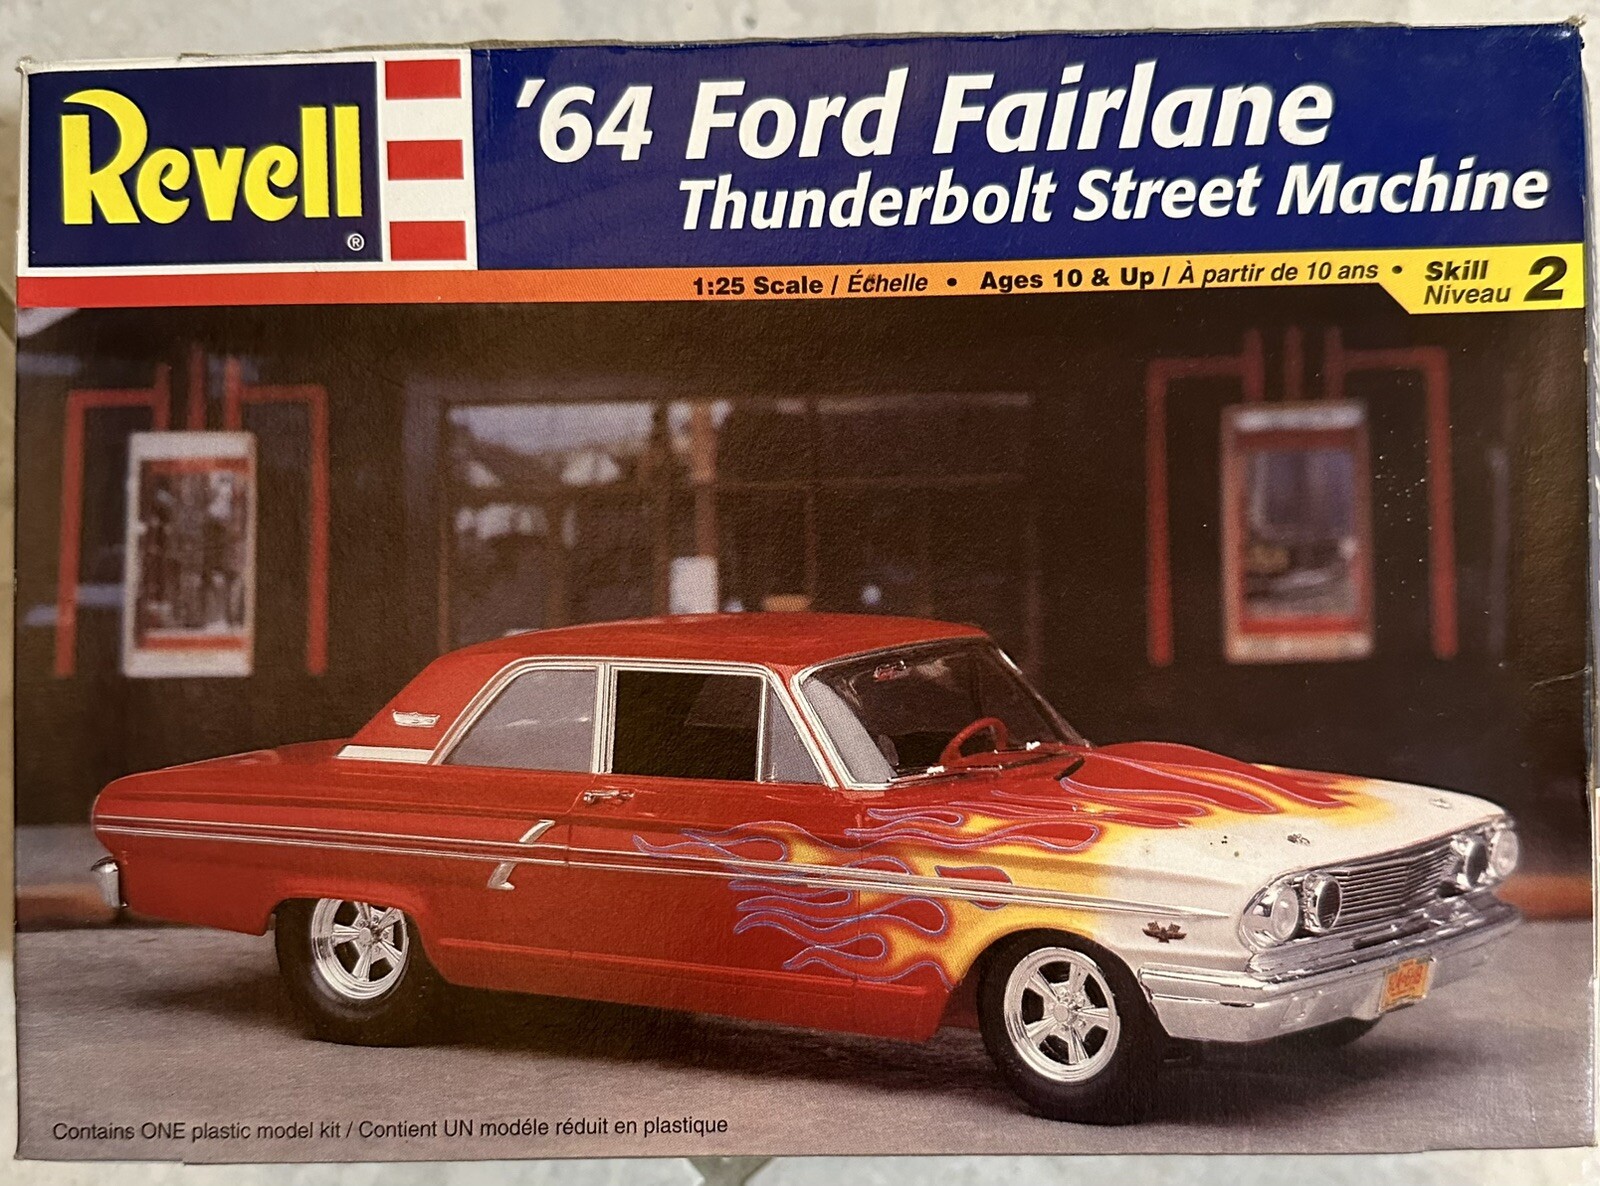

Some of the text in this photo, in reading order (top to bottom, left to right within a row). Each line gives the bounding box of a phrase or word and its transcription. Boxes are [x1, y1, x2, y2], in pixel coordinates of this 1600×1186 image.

[686, 67, 909, 162] Ford
[932, 60, 1335, 156] Fairlane
[61, 88, 363, 225] Revell
[678, 154, 1550, 232] Thunderbolt Street Machine
[692, 277, 746, 296] 1:25
[753, 274, 824, 296] Scale
[847, 269, 929, 294] Échelle
[979, 271, 1043, 294] Ages
[1052, 269, 1083, 288] 10
[1090, 267, 1111, 287] &
[1120, 267, 1155, 289] Up
[1178, 260, 1196, 285] À
[1200, 262, 1265, 288] partir
[1270, 263, 1299, 282] de
[1306, 262, 1332, 280] 10
[1338, 264, 1379, 279] ans
[1423, 284, 1513, 305] Niveau
[1424, 256, 1569, 303] Skill 2
[52, 1121, 135, 1141] Contains
[141, 1121, 186, 1140] ONE
[192, 1121, 251, 1143] plastic
[257, 1121, 314, 1139] model
[320, 1120, 341, 1138] kit
[358, 1118, 438, 1138] Contient
[444, 1118, 474, 1137] UN
[480, 1117, 550, 1137] modéle
[556, 1116, 609, 1135] réduit
[614, 1119, 638, 1134] en
[643, 1114, 729, 1138] plastique
